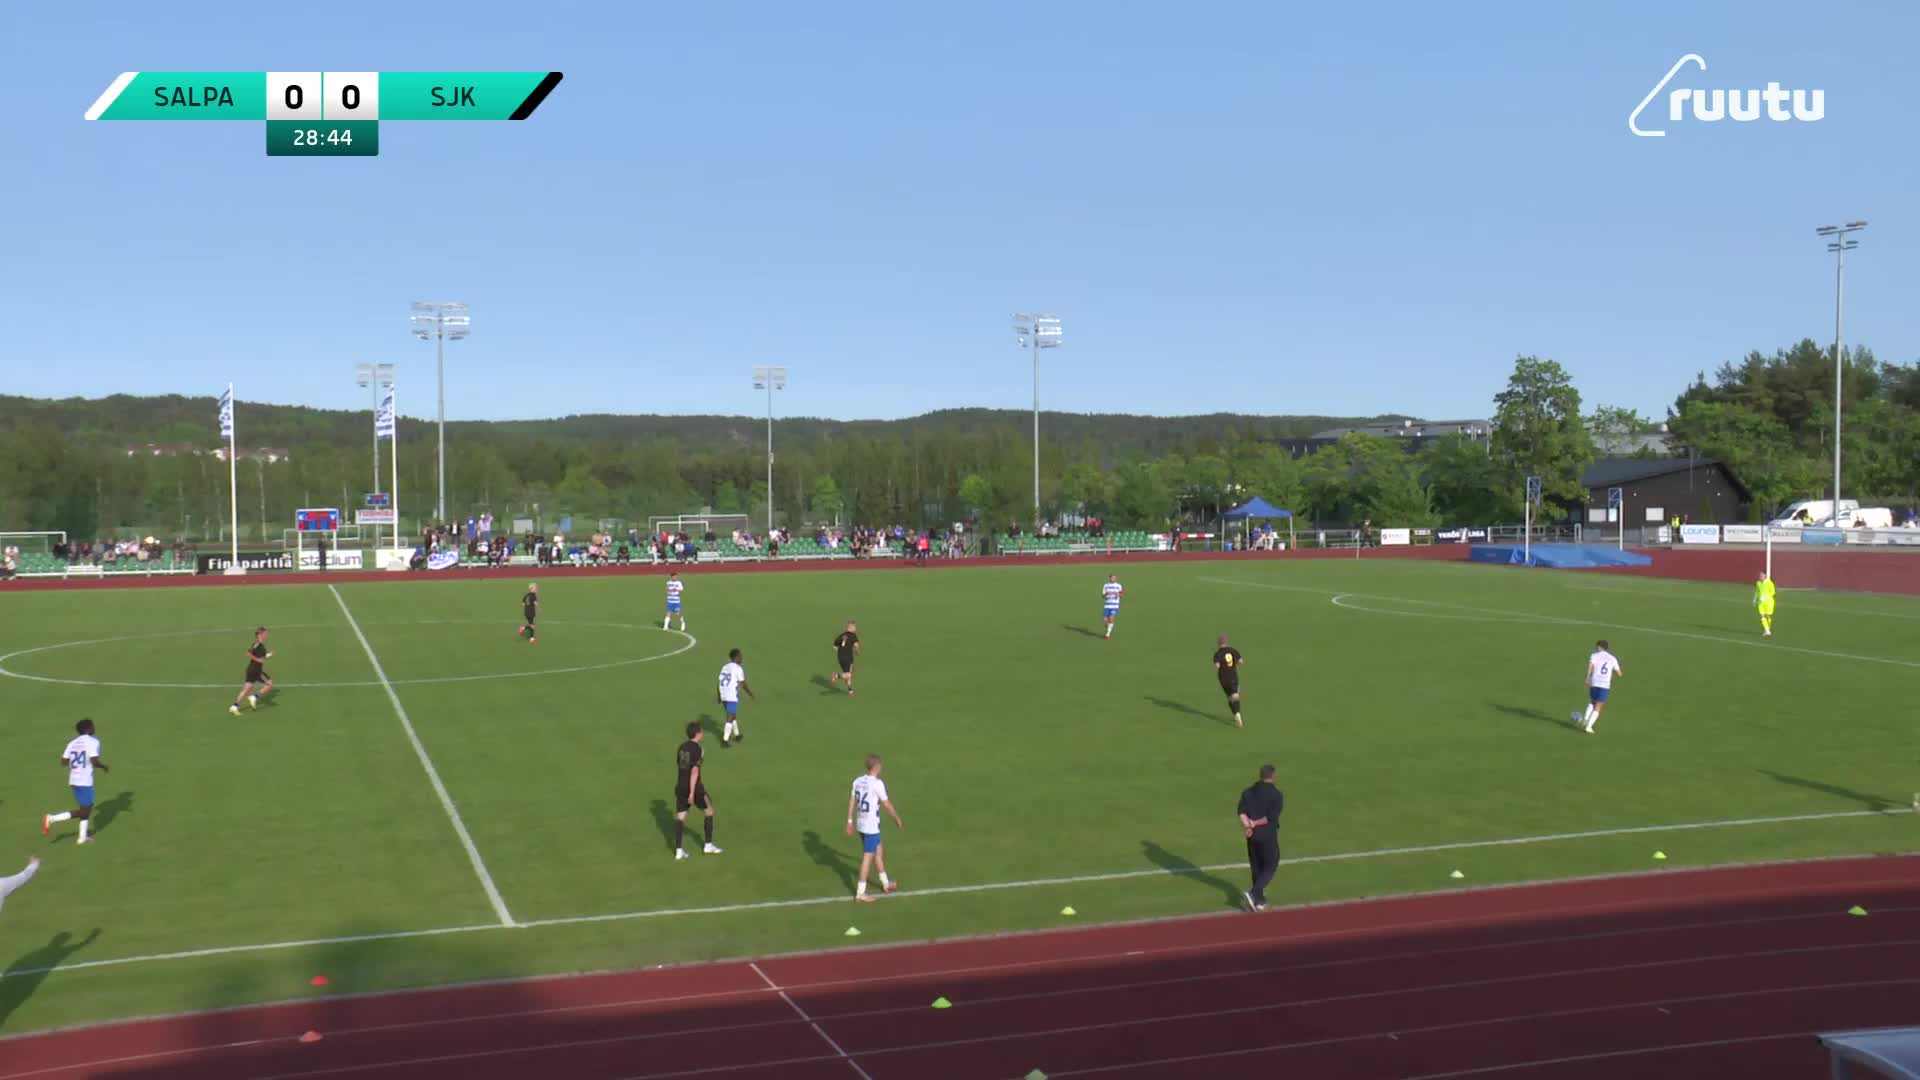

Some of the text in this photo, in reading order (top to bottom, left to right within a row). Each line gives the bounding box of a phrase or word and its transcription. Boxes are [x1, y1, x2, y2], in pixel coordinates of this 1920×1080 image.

[1224, 652, 1233, 667] 9
[1600, 661, 1608, 675] 6
[70, 750, 87, 769] 24
